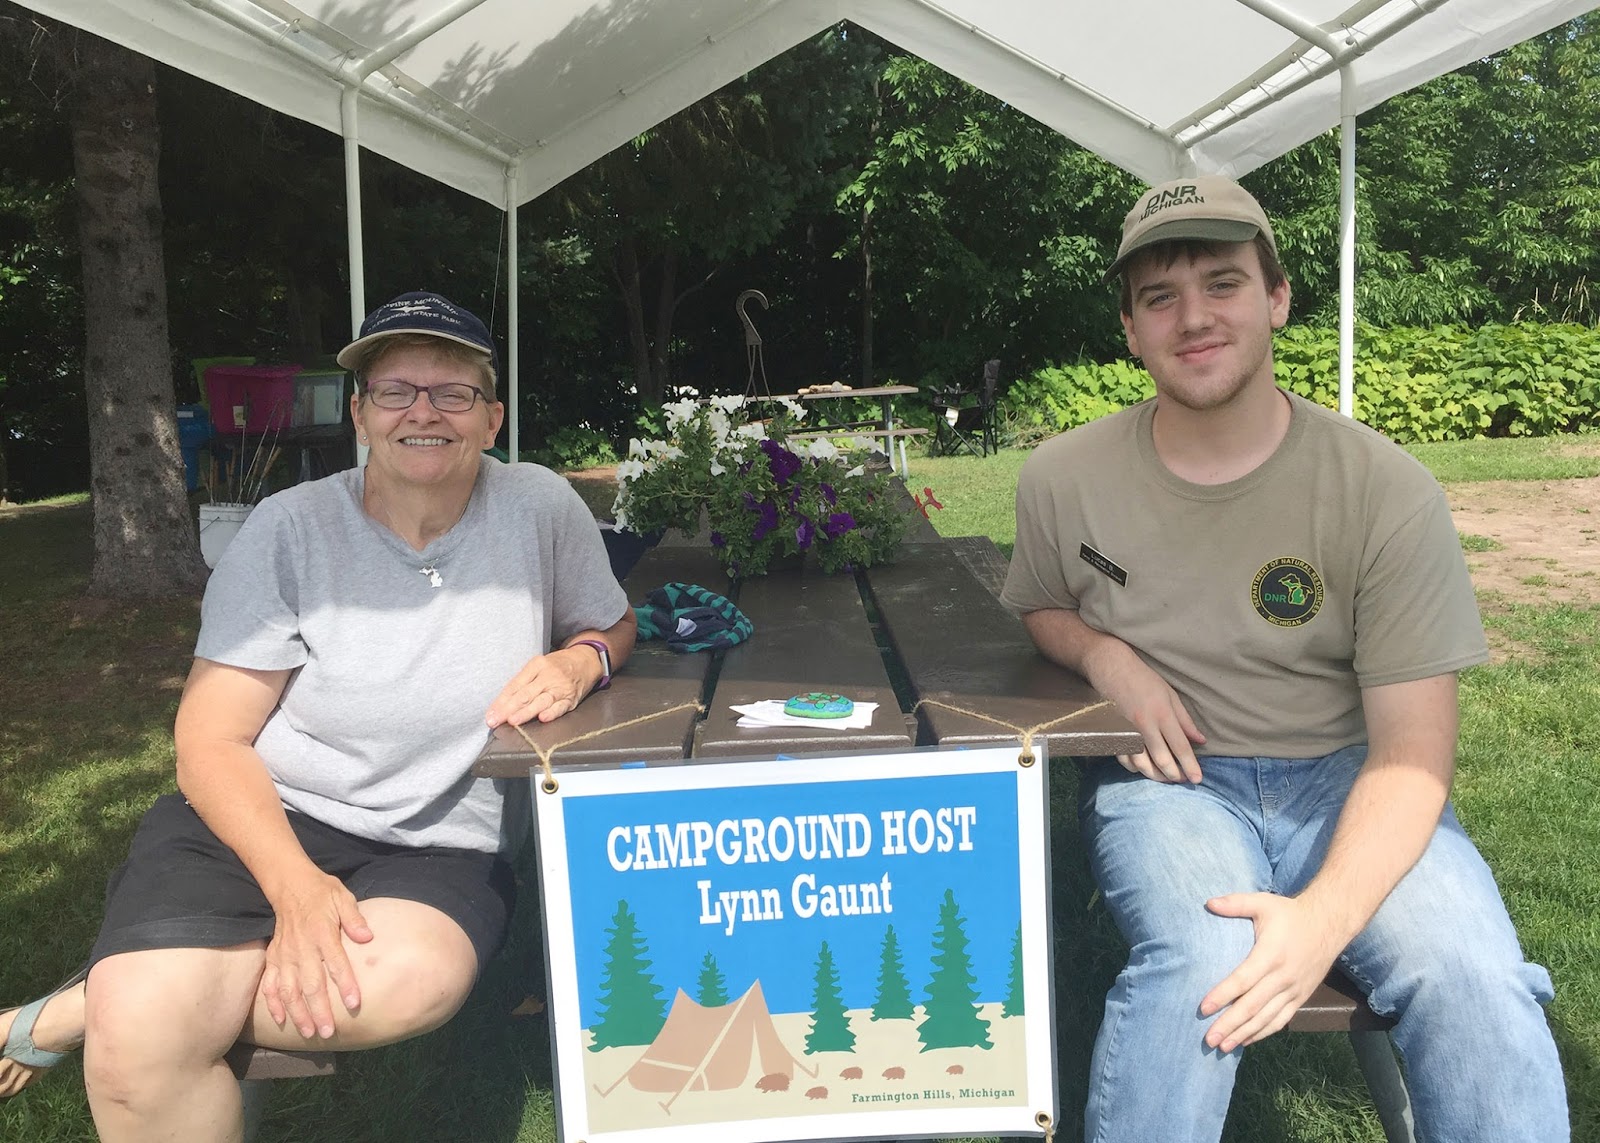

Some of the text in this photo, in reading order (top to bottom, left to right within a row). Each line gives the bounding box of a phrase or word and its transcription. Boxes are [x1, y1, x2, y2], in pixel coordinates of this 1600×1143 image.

[1138, 196, 1205, 224] MICHIGAN
[1145, 185, 1197, 211] DNR
[1252, 558, 1323, 614] DEPARTMENT OF NATURAL RESOURCES
[1264, 593, 1287, 603] DNR
[1267, 615, 1302, 627] MICHIGAN
[606, 806, 977, 872] CAMPGROUND HOST
[697, 872, 893, 936] Lynn Gaunt
[851, 1088, 1015, 1103] Farmington Hills, Michigan
